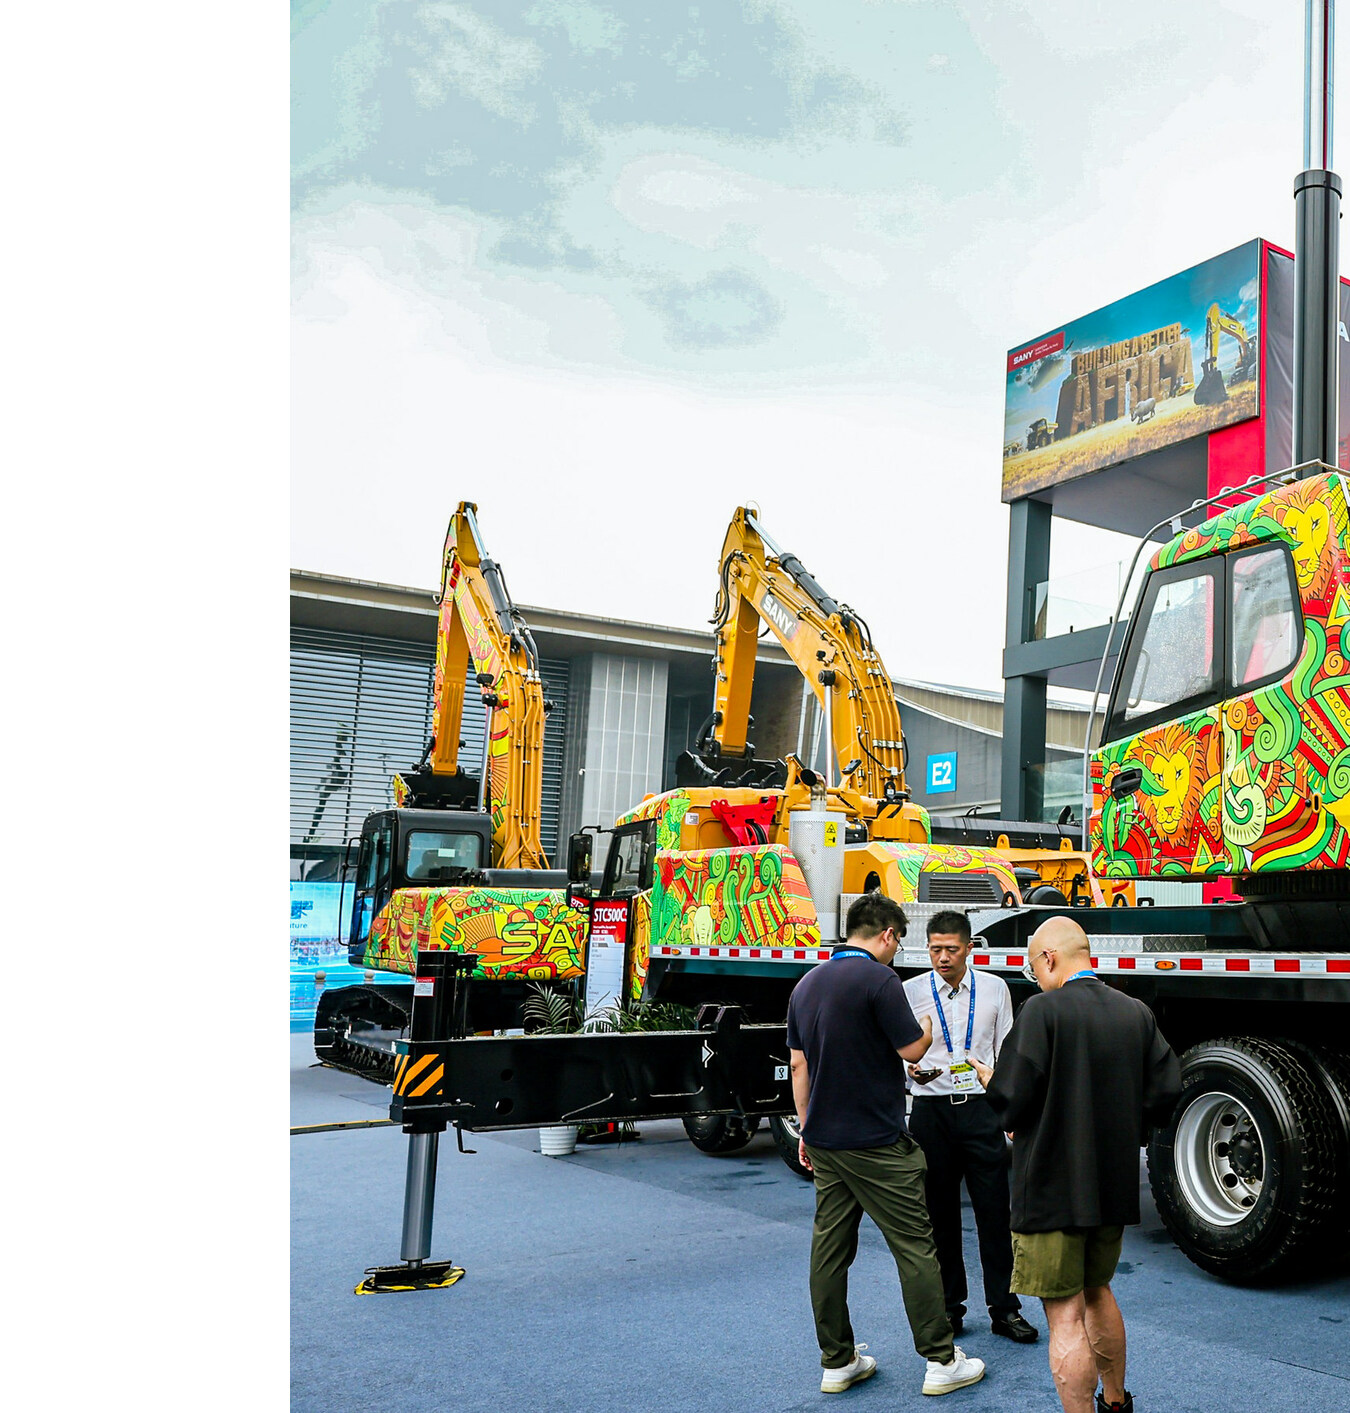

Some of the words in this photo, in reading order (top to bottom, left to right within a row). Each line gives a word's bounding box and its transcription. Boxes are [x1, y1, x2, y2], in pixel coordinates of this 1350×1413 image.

[1013, 350, 1034, 365] SANY
[1076, 341, 1130, 375] BUILDING
[1141, 322, 1182, 354] BETTER
[1068, 337, 1195, 437] AFRICA
[763, 594, 793, 635] SANY
[932, 761, 952, 786] E2
[501, 922, 589, 955] SA
